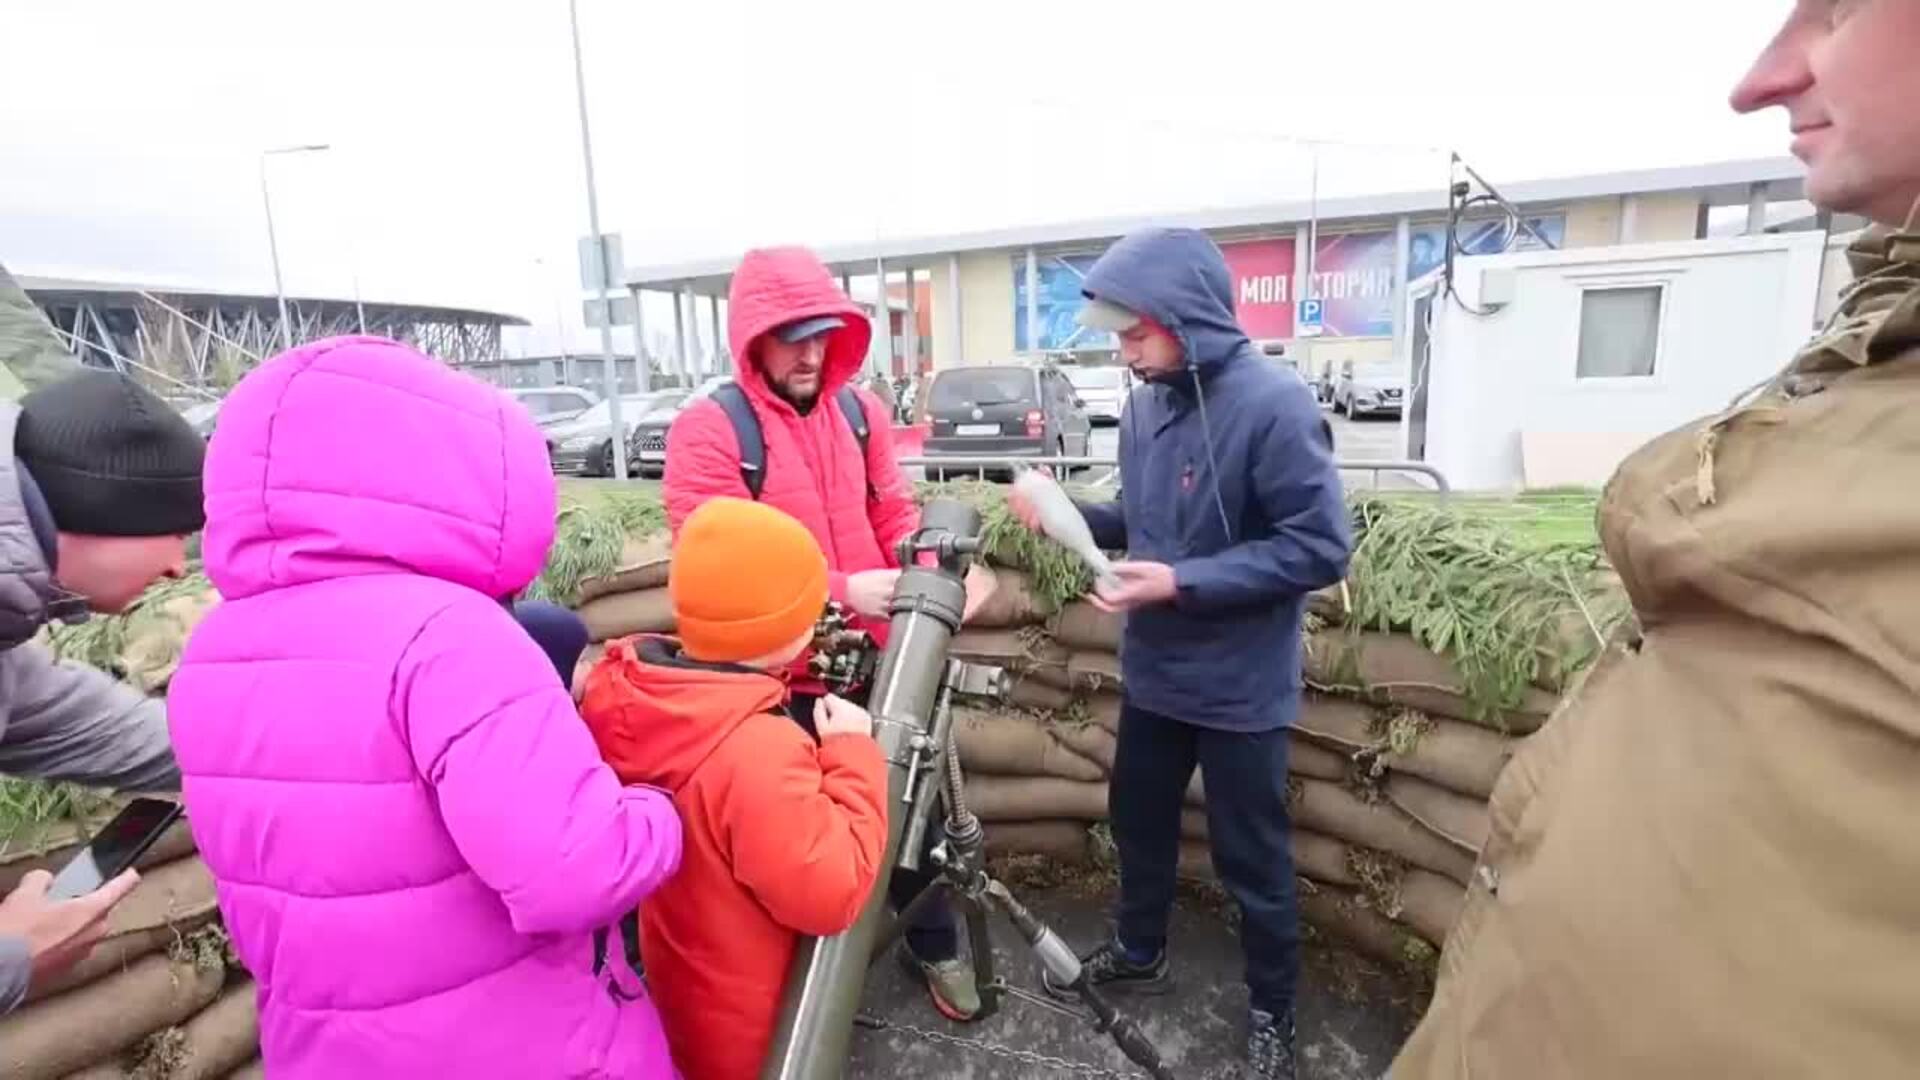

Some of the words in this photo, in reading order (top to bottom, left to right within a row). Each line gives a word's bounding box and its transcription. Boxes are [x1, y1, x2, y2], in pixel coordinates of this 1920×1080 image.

[1240, 274, 1287, 304] МОЯ
[1292, 267, 1392, 302] СТОРИЯ
[1305, 301, 1319, 321] P
